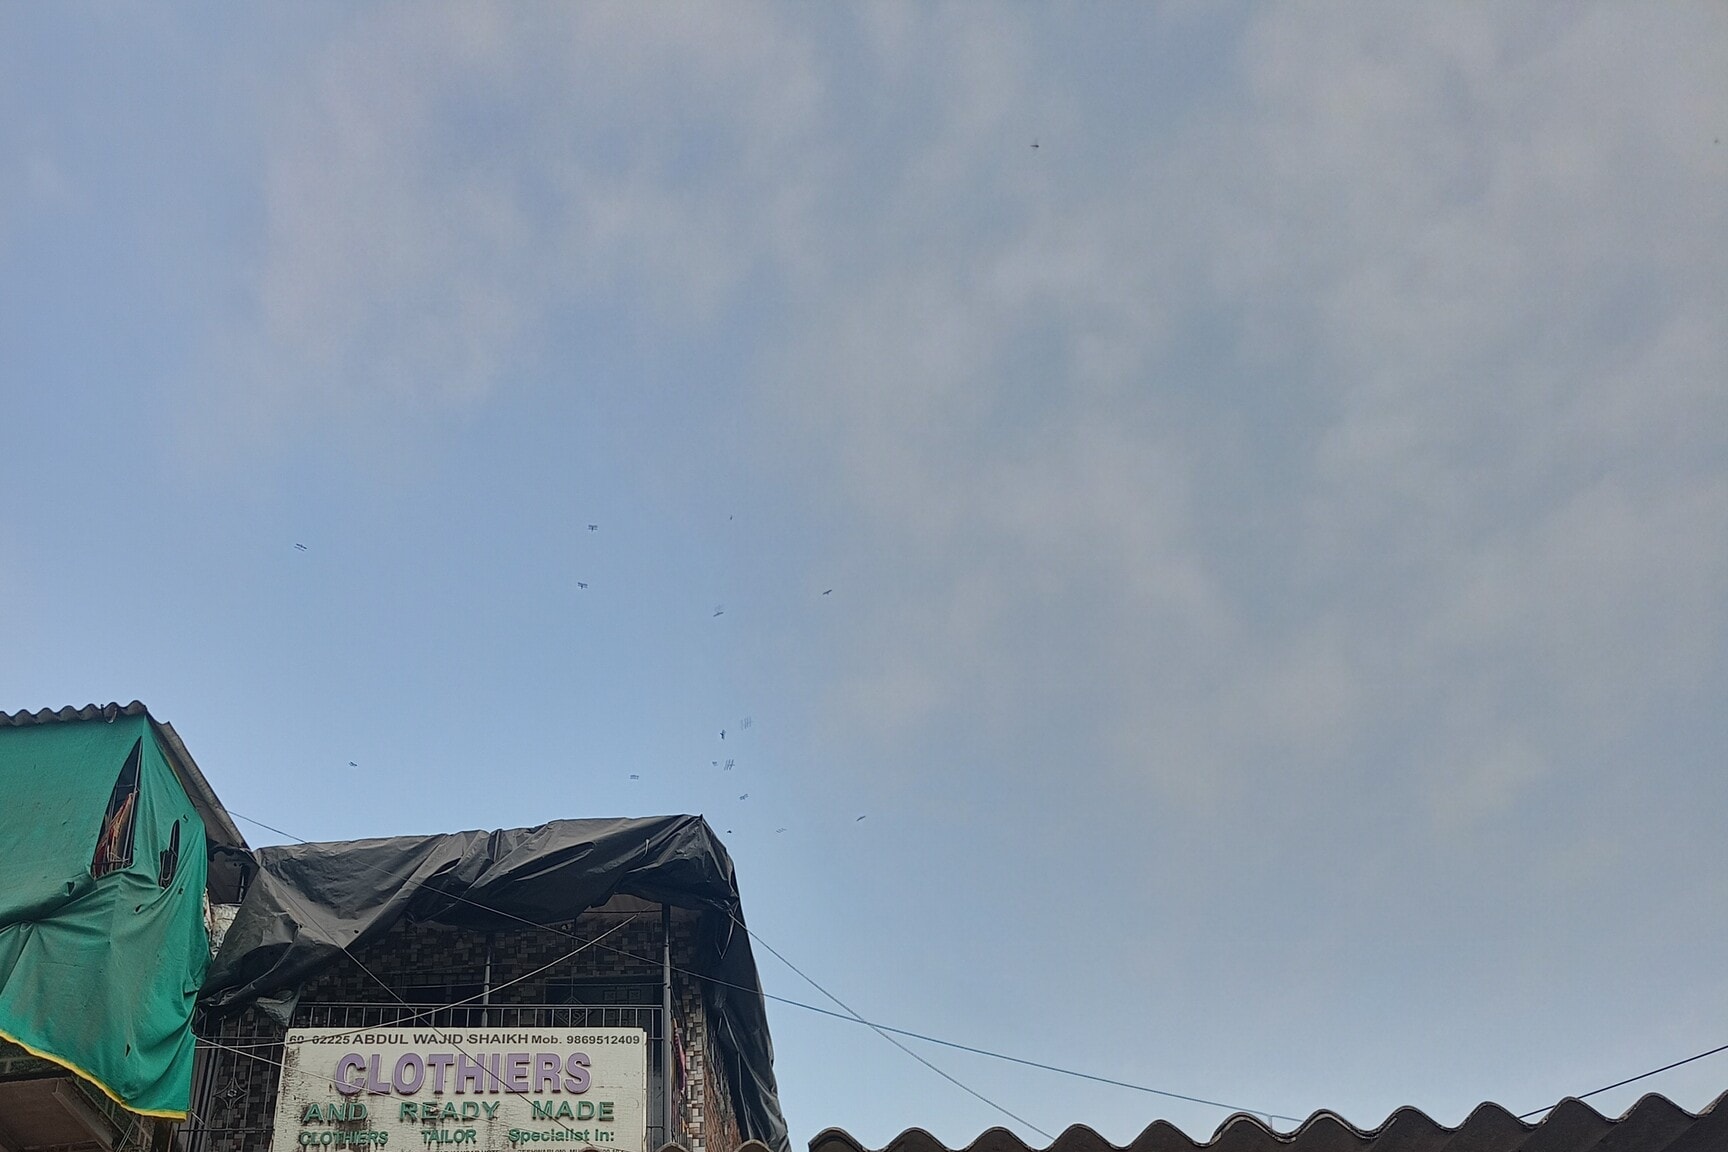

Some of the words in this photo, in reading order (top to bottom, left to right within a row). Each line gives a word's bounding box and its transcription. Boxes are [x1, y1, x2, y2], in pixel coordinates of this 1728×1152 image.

[352, 1033, 409, 1046] ABDUL
[412, 1033, 465, 1045] WAJID
[468, 1033, 529, 1045] SHAIKH
[531, 1034, 562, 1044] Mob.
[566, 1035, 640, 1045] 9869512409
[335, 1051, 592, 1095] CLOTHIERS
[303, 1102, 368, 1123] AND
[399, 1100, 501, 1123] READY
[532, 1100, 615, 1121] MADE
[299, 1129, 389, 1147] CLOTHIERS
[421, 1128, 477, 1145] TAILOR
[508, 1128, 590, 1146] Specialist
